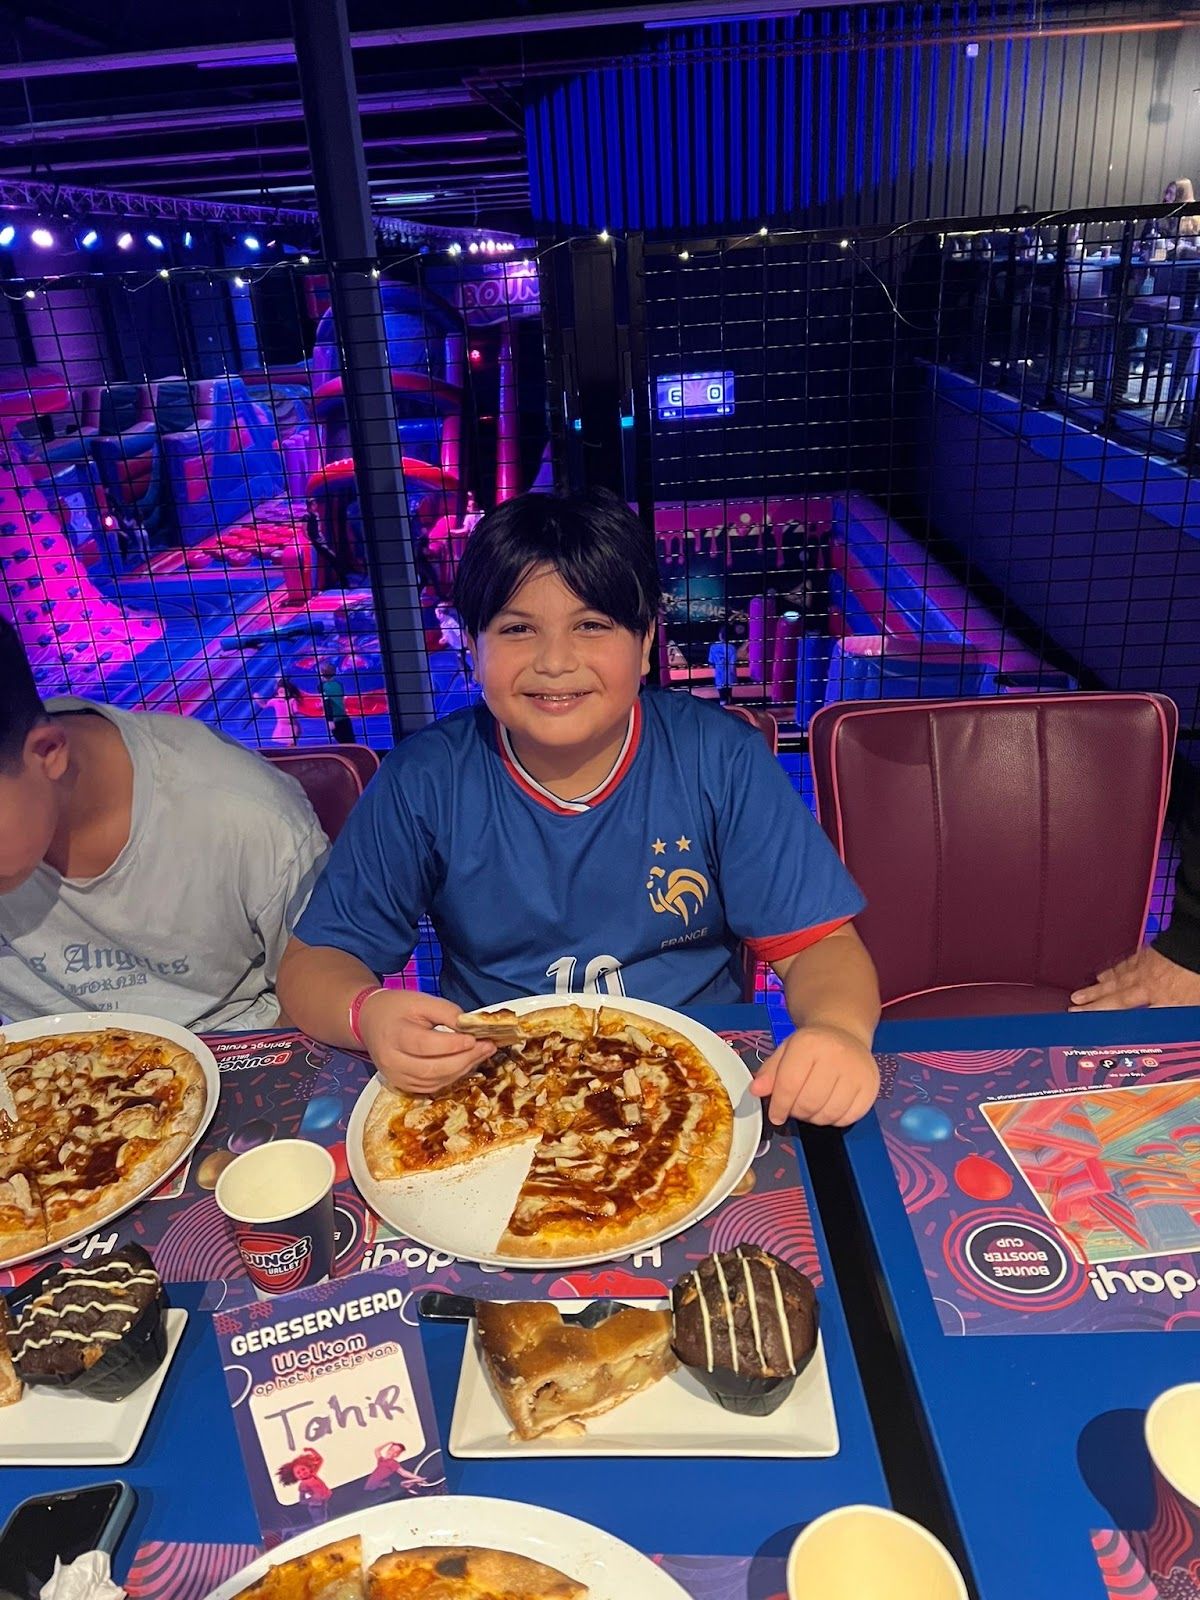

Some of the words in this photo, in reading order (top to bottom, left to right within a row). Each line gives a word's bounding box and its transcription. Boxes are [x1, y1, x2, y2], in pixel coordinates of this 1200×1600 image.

[660, 927, 708, 949] FRANCE
[546, 954, 626, 997] 10
[216, 1043, 249, 1051] eruit!
[250, 1041, 292, 1051] Springt
[217, 1050, 293, 1073] BOUNC
[240, 1236, 312, 1268] OUNCE
[996, 1237, 1024, 1248] CUP
[267, 1260, 302, 1276] VALLEY
[984, 1251, 1048, 1263] BOOSTER
[994, 1265, 1050, 1277] BOUNCE
[230, 1288, 403, 1356] GERESERVEERD
[274, 1334, 366, 1373] Welkom
[255, 1383, 274, 1396] op
[278, 1372, 306, 1390] het
[309, 1354, 364, 1380] feestje
